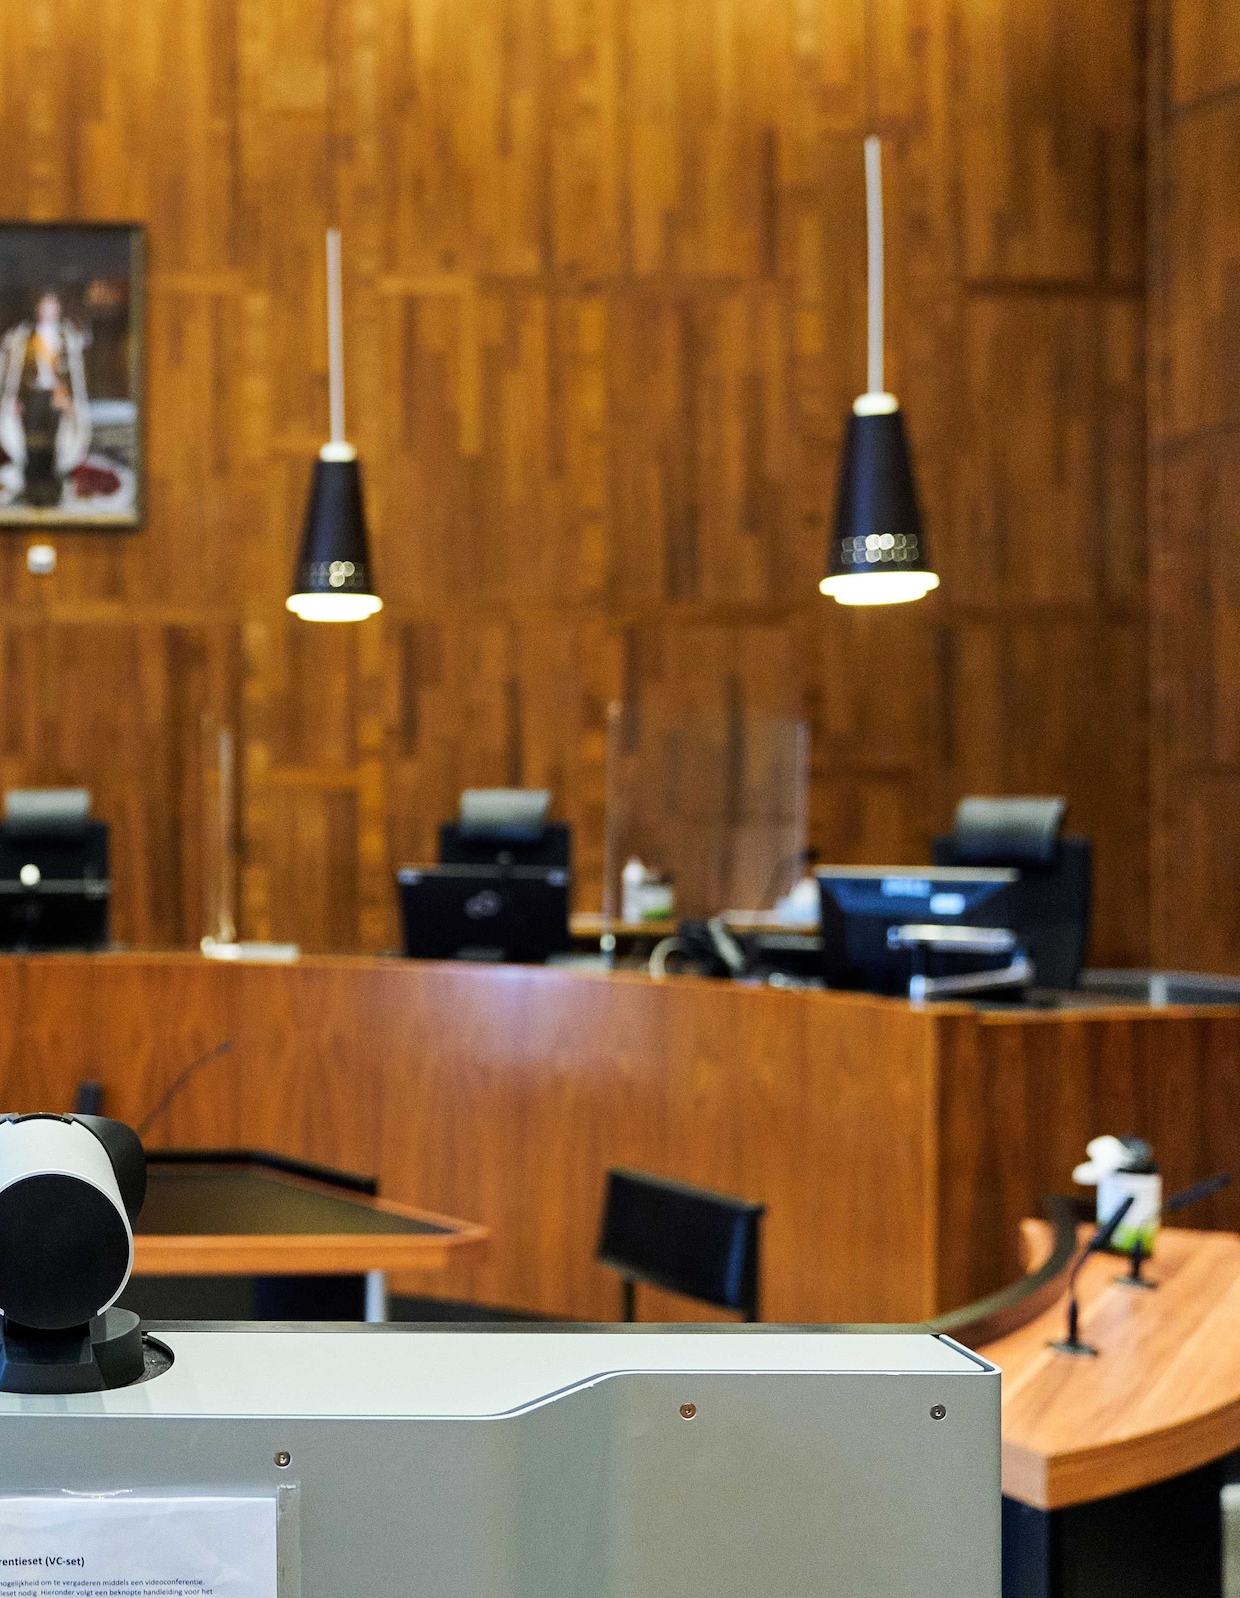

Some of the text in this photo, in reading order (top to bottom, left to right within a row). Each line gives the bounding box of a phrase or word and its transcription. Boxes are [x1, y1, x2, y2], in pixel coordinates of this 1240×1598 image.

[45, 1556, 85, 1567] (VC-set)
[110, 1588, 142, 1597] beknopte
[143, 1588, 183, 1596] handleiding
